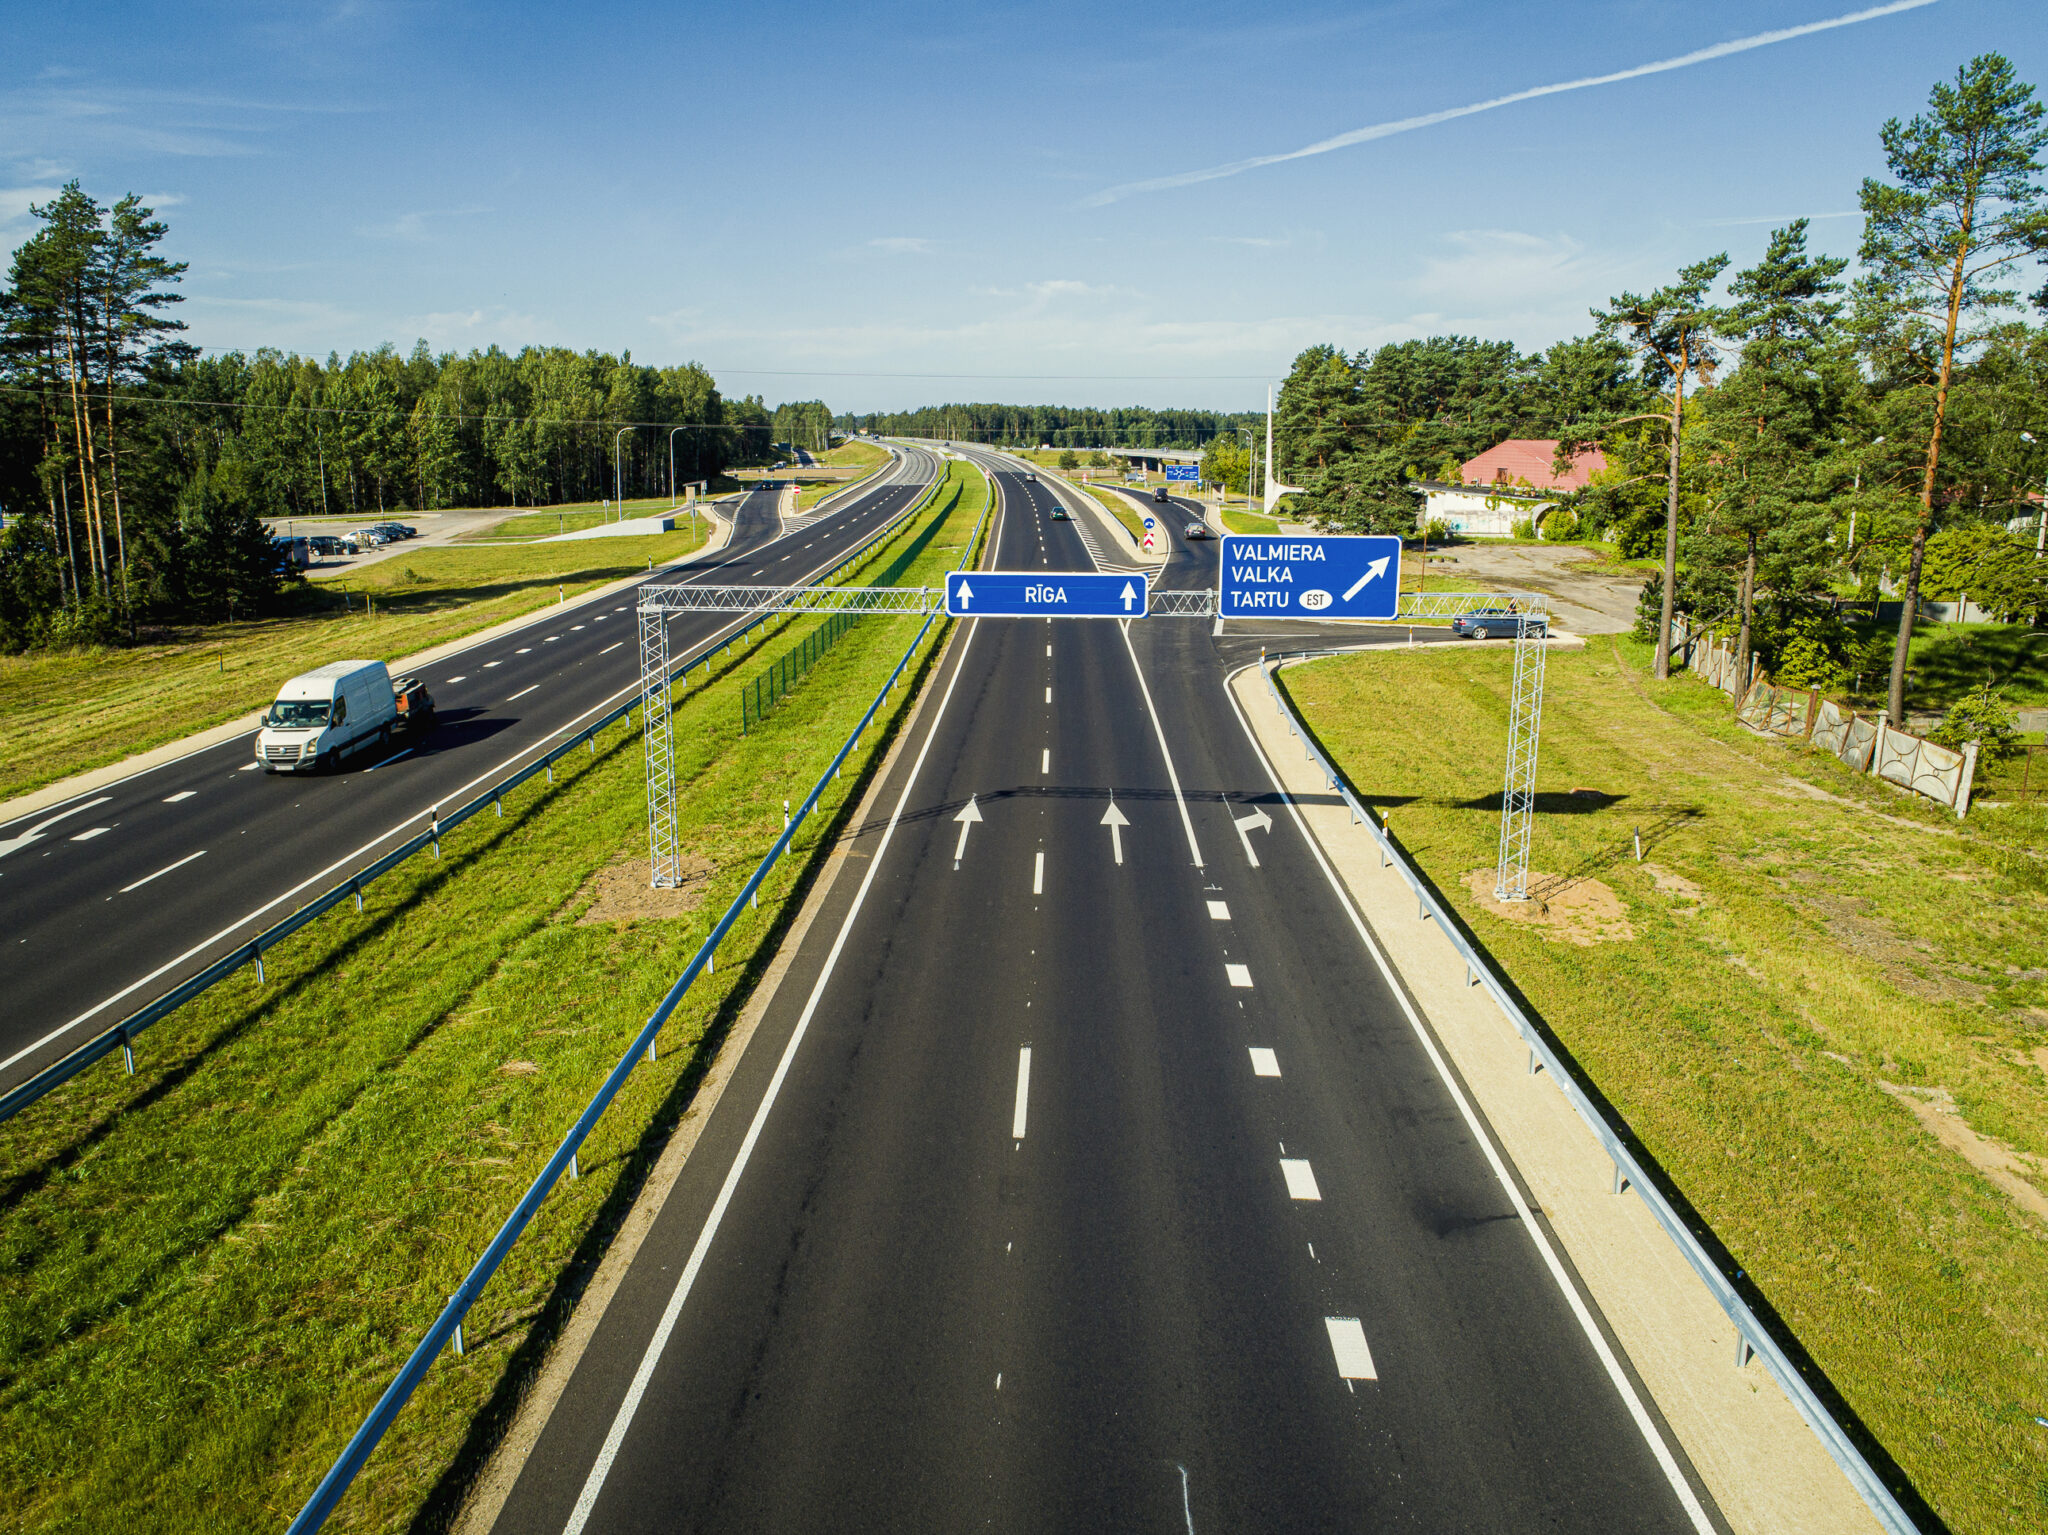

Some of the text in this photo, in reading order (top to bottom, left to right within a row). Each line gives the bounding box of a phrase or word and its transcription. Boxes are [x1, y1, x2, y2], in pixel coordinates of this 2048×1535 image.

[1232, 544, 1326, 562] VALMIERA
[1232, 566, 1293, 583] VALKA
[1025, 584, 1068, 603] RĪGA
[1231, 591, 1324, 608] TARTU EST
